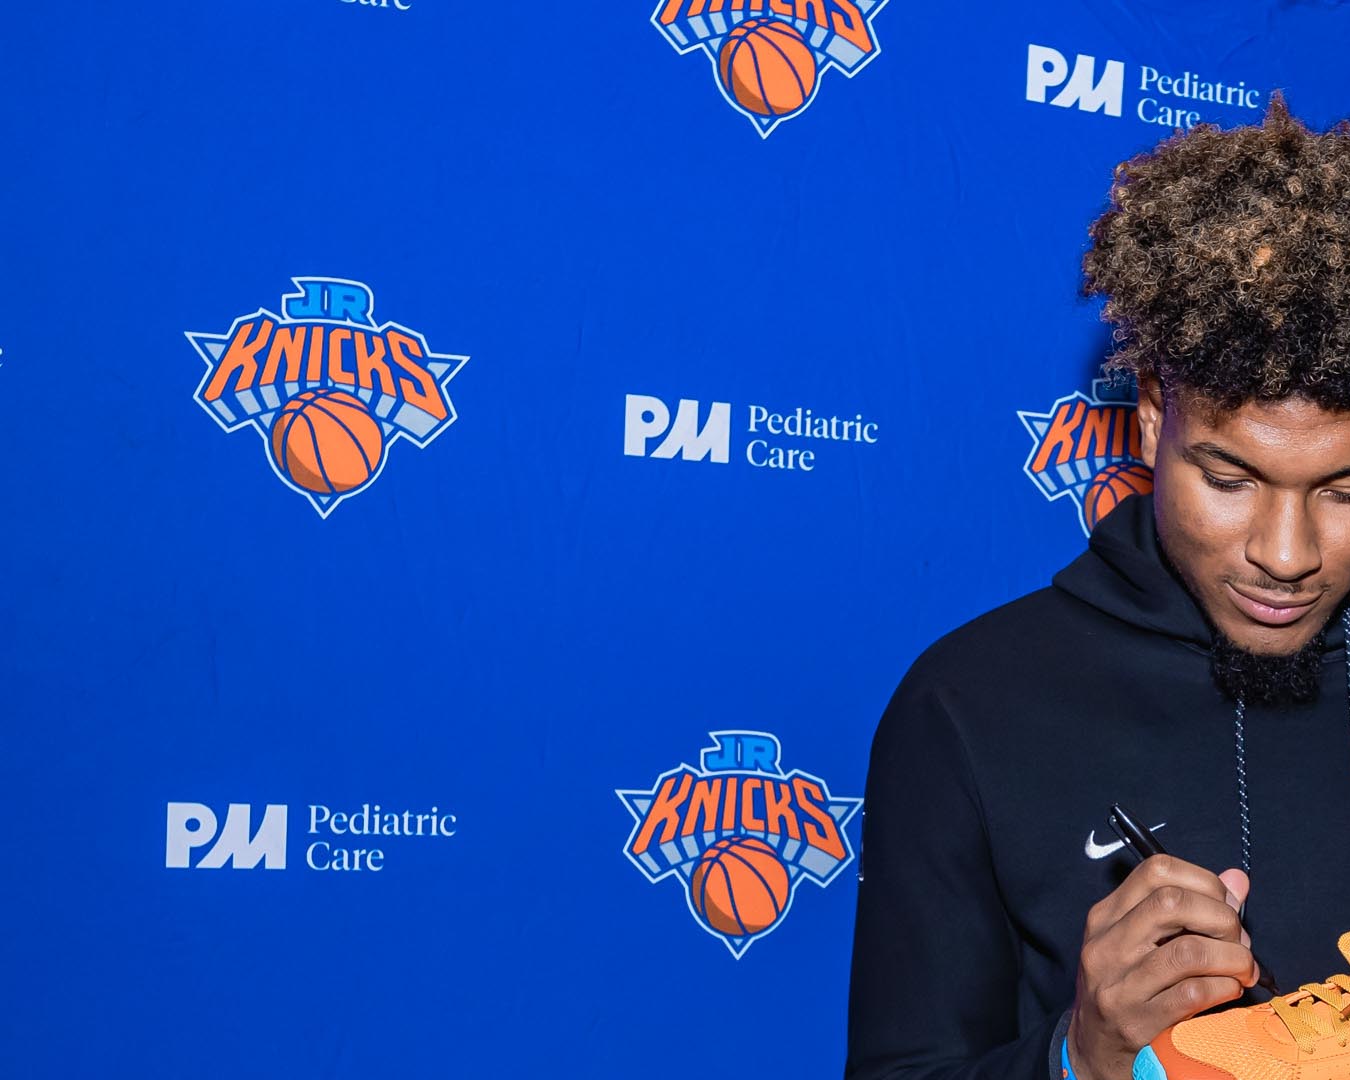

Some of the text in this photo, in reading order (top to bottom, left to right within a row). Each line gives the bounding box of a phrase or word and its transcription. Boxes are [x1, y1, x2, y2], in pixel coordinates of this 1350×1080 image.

[1026, 43, 1124, 117] PM
[1139, 65, 1260, 109] Pediatric
[1137, 98, 1200, 129] Care
[288, 283, 367, 323] JR
[204, 320, 447, 420] KNICKS
[624, 394, 731, 464] PM
[748, 405, 879, 445] Pediatric
[746, 438, 815, 472] Care
[706, 736, 775, 771] JR
[165, 802, 288, 870] PM
[307, 803, 457, 838] Pediatric
[633, 774, 846, 860] KNICKS
[305, 841, 385, 873] Care
